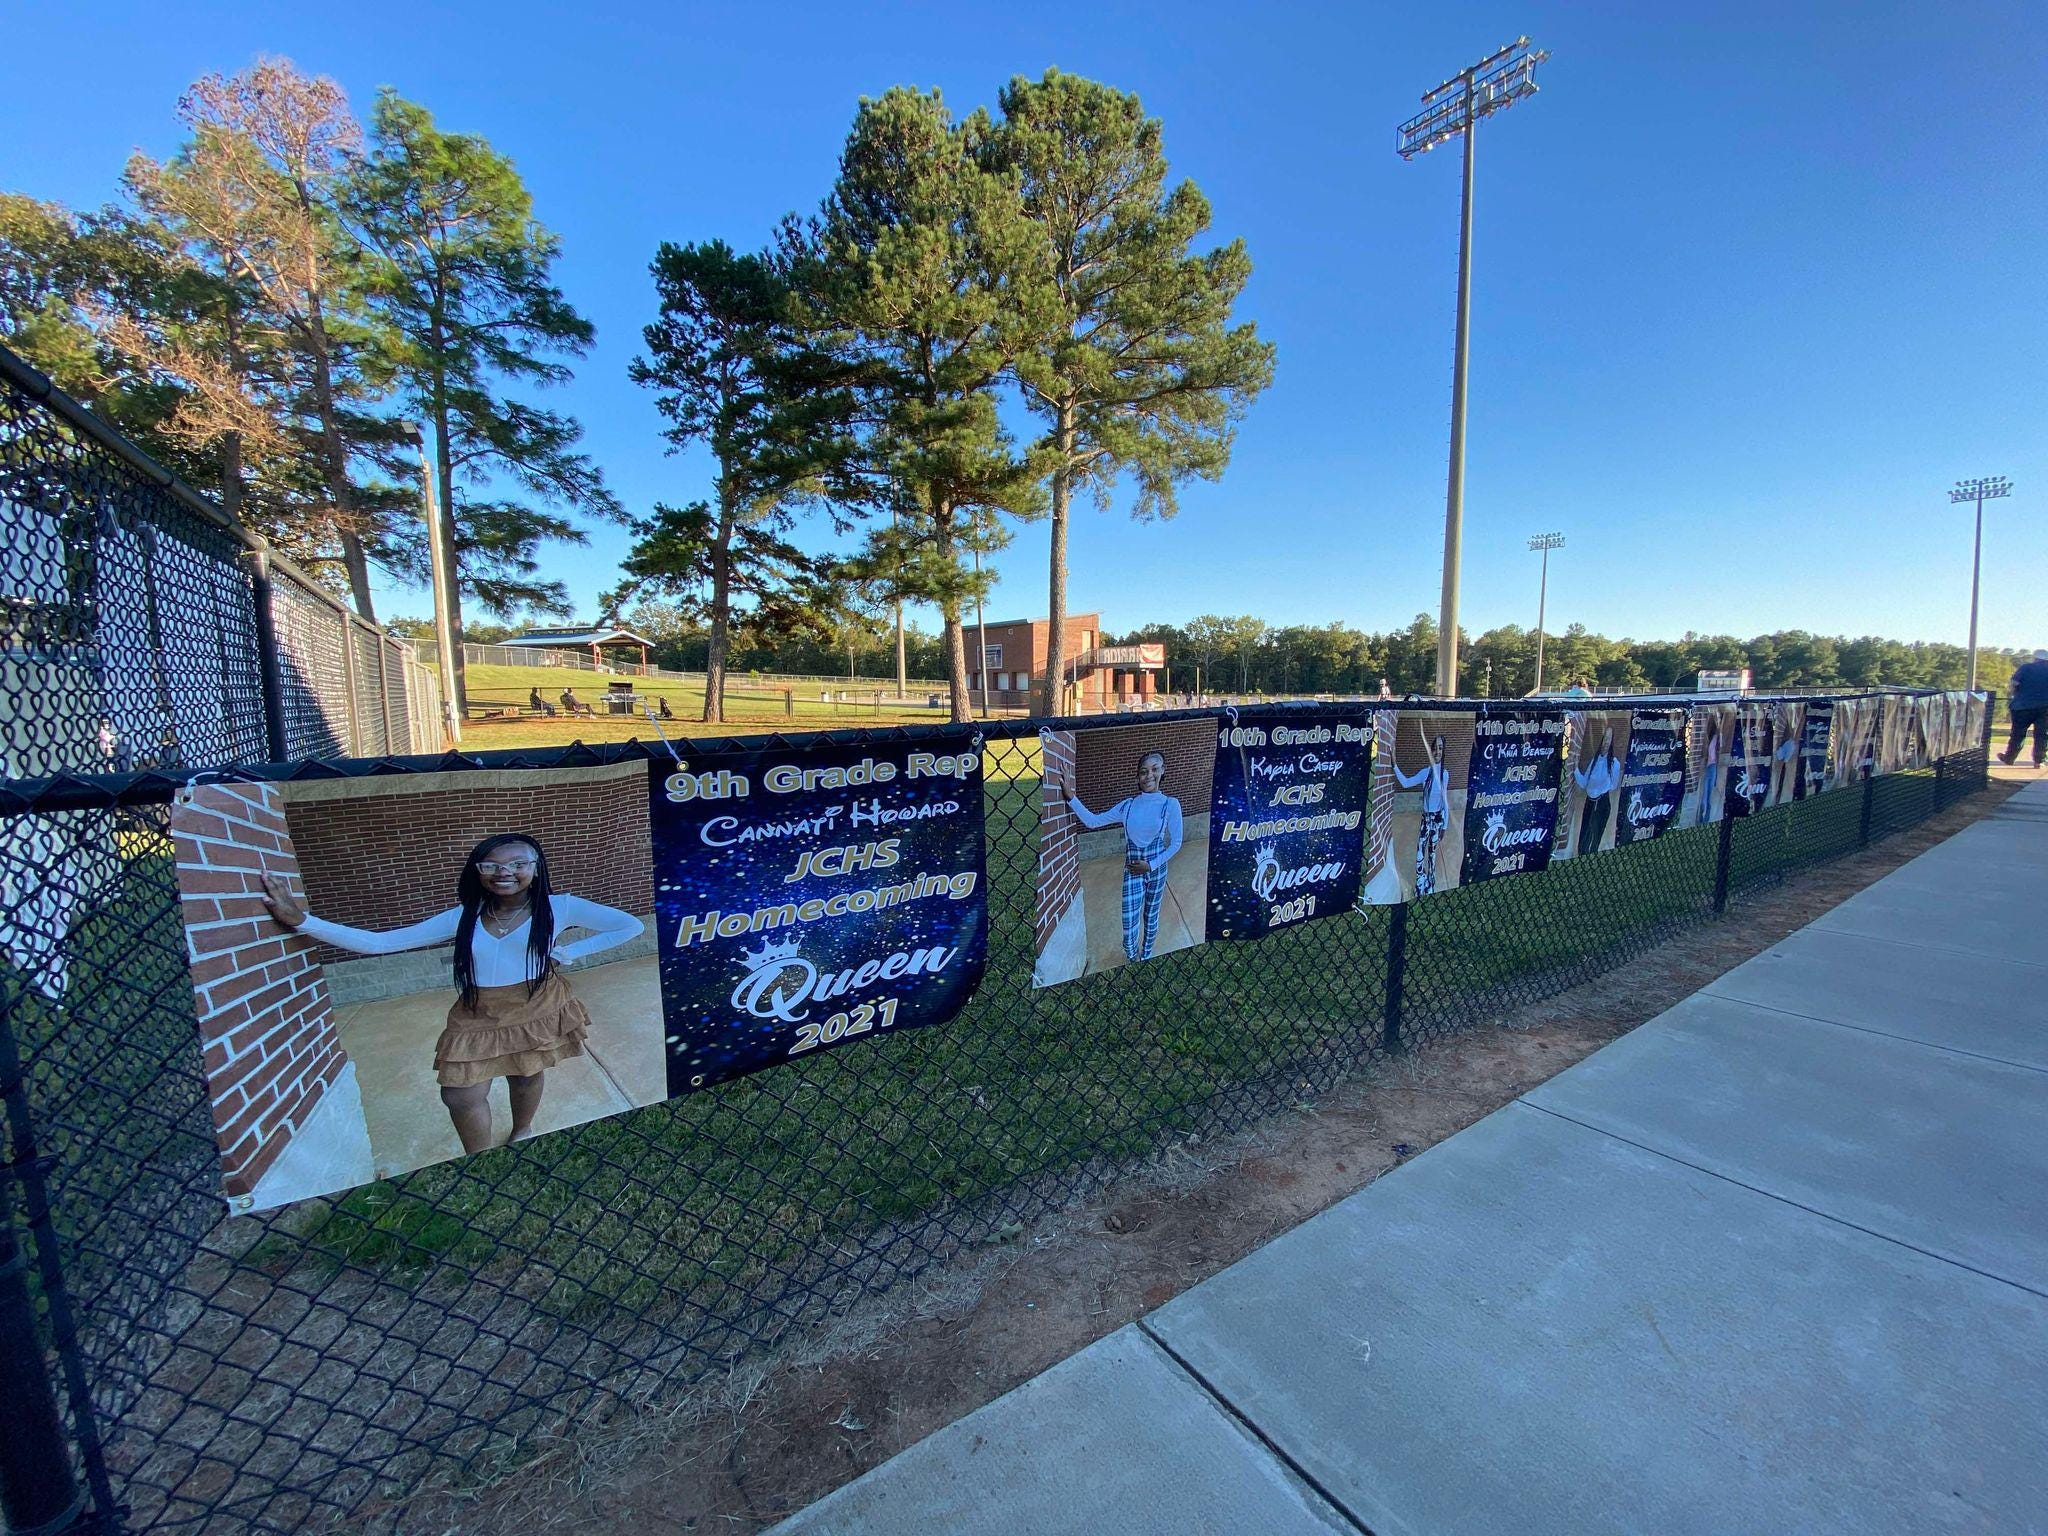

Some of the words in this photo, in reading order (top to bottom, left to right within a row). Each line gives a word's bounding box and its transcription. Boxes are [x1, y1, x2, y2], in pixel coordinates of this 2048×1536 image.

[1219, 727, 1266, 747] 10th
[1272, 727, 1331, 746] Grade
[1335, 725, 1373, 746] Rep
[1476, 720, 1503, 735] 11th
[1542, 720, 1565, 736] Rep
[665, 770, 749, 802] 9th
[763, 758, 896, 794] Grade
[907, 753, 978, 780] Rep
[1502, 765, 1537, 783] JCHS
[1268, 783, 1326, 807] JCHS
[1473, 785, 1557, 809] Homecoming
[1221, 809, 1362, 842] Homecoming
[1482, 823, 1548, 856] Queen
[784, 839, 900, 883] JCHS
[1492, 853, 1525, 875] 2021
[1251, 858, 1346, 901] Queen
[675, 872, 977, 947] Homecoming
[1268, 895, 1316, 927] 2021
[730, 946, 958, 1022] Queen
[787, 998, 899, 1055] 2021
